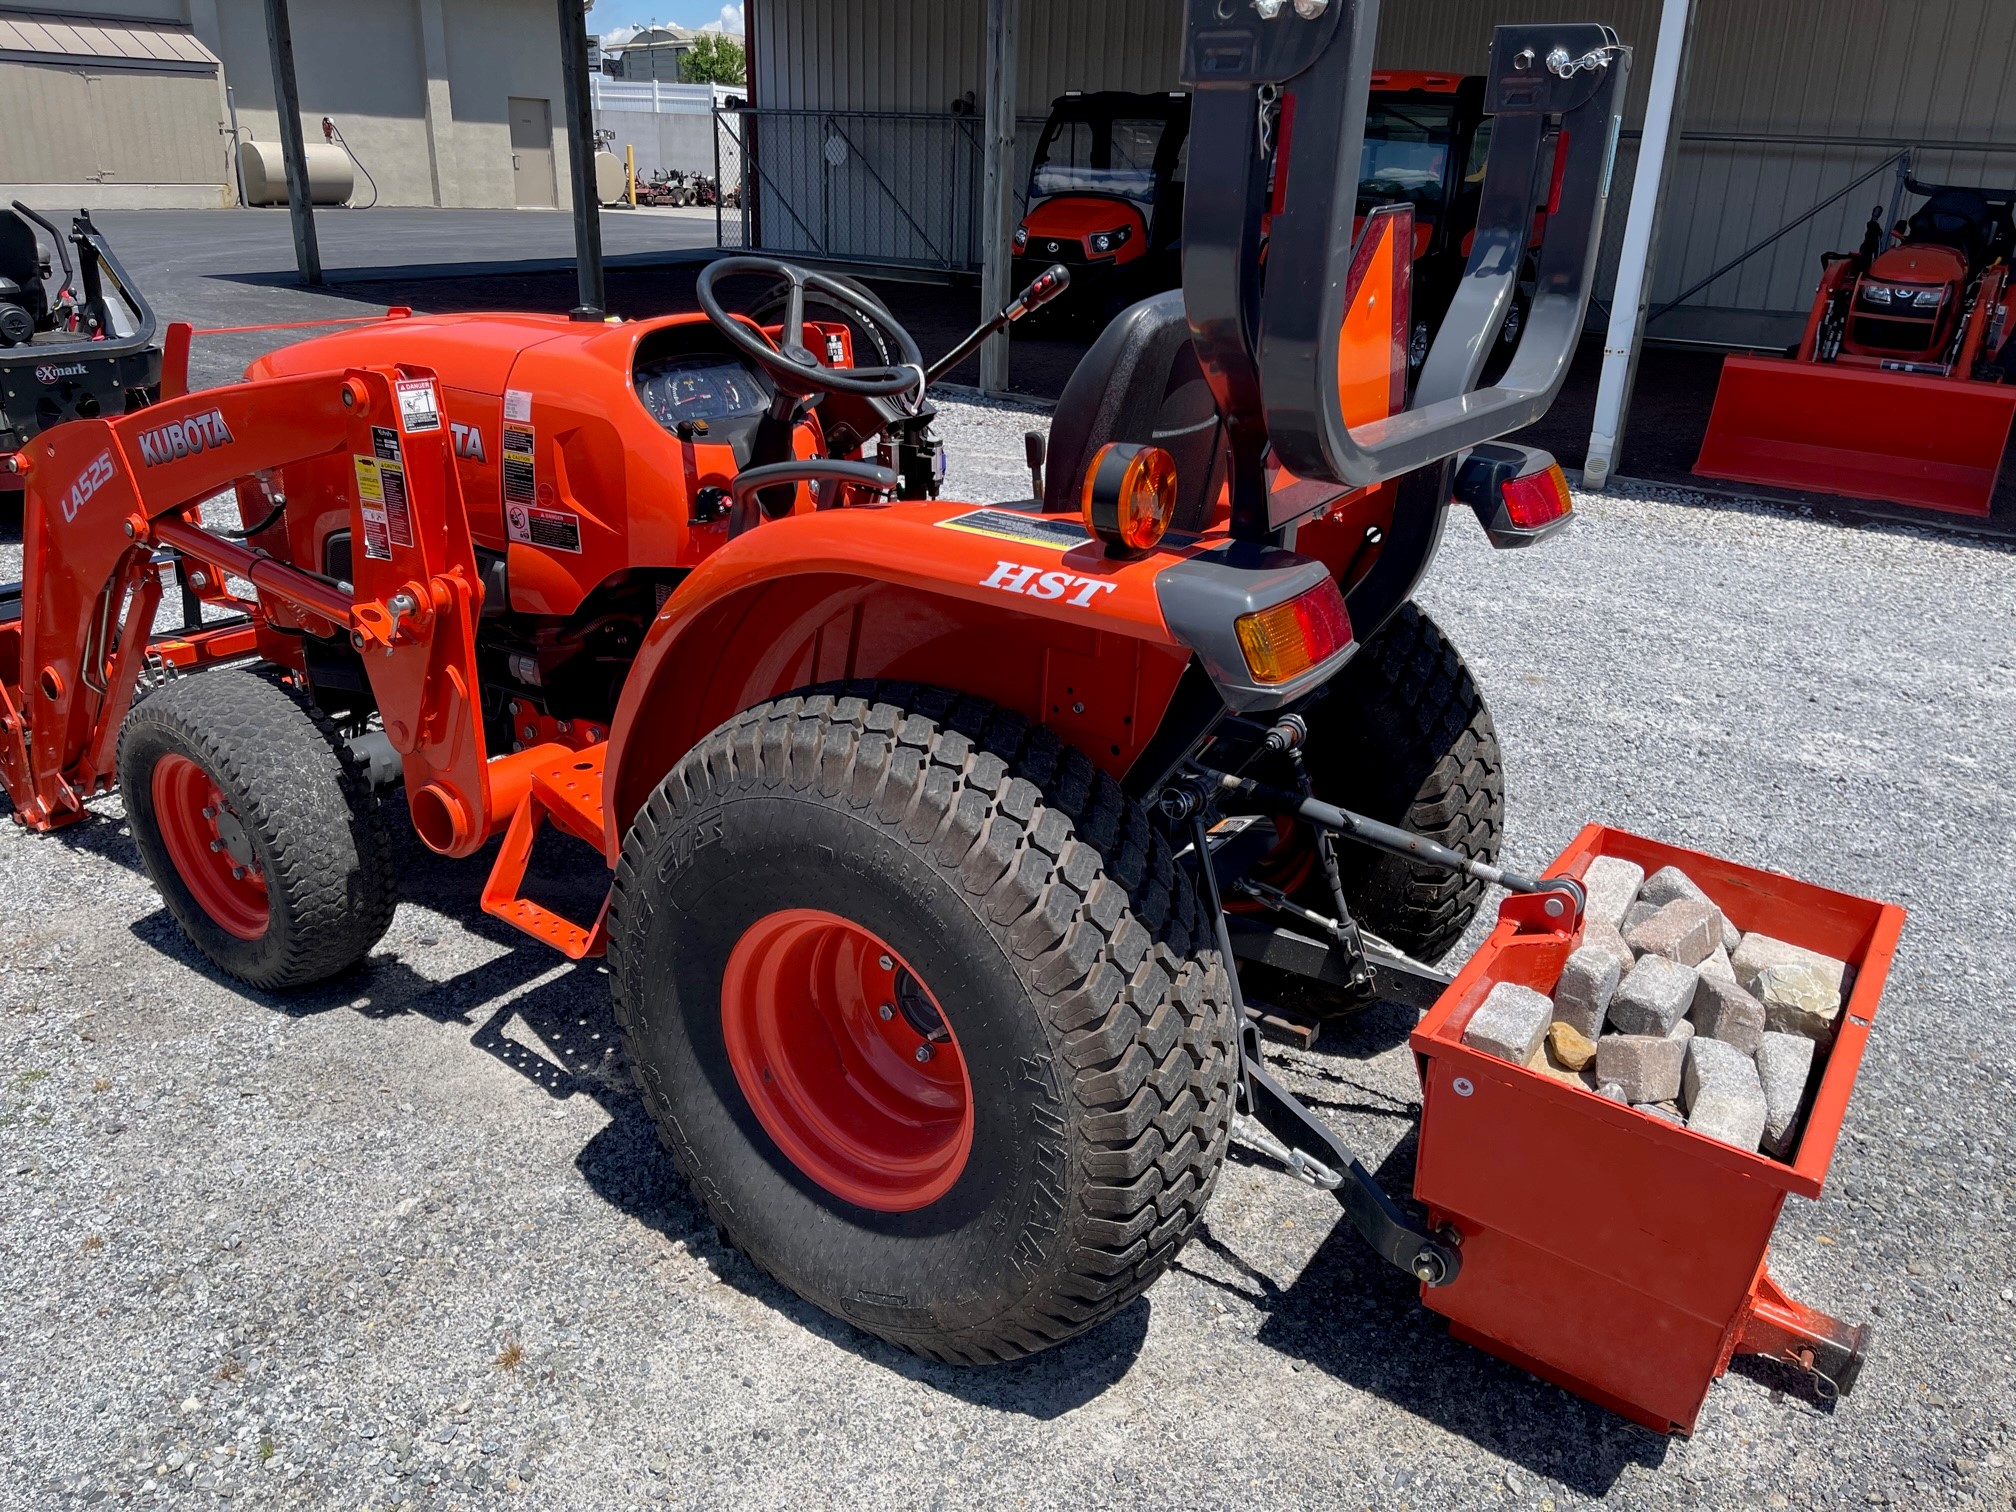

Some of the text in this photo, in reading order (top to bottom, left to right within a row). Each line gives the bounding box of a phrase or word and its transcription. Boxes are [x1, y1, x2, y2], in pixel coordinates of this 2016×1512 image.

[138, 409, 233, 467] KUBOTA
[61, 452, 115, 523] LA525
[979, 560, 1118, 608] HST
[1009, 1053, 1068, 1284] TITAN
